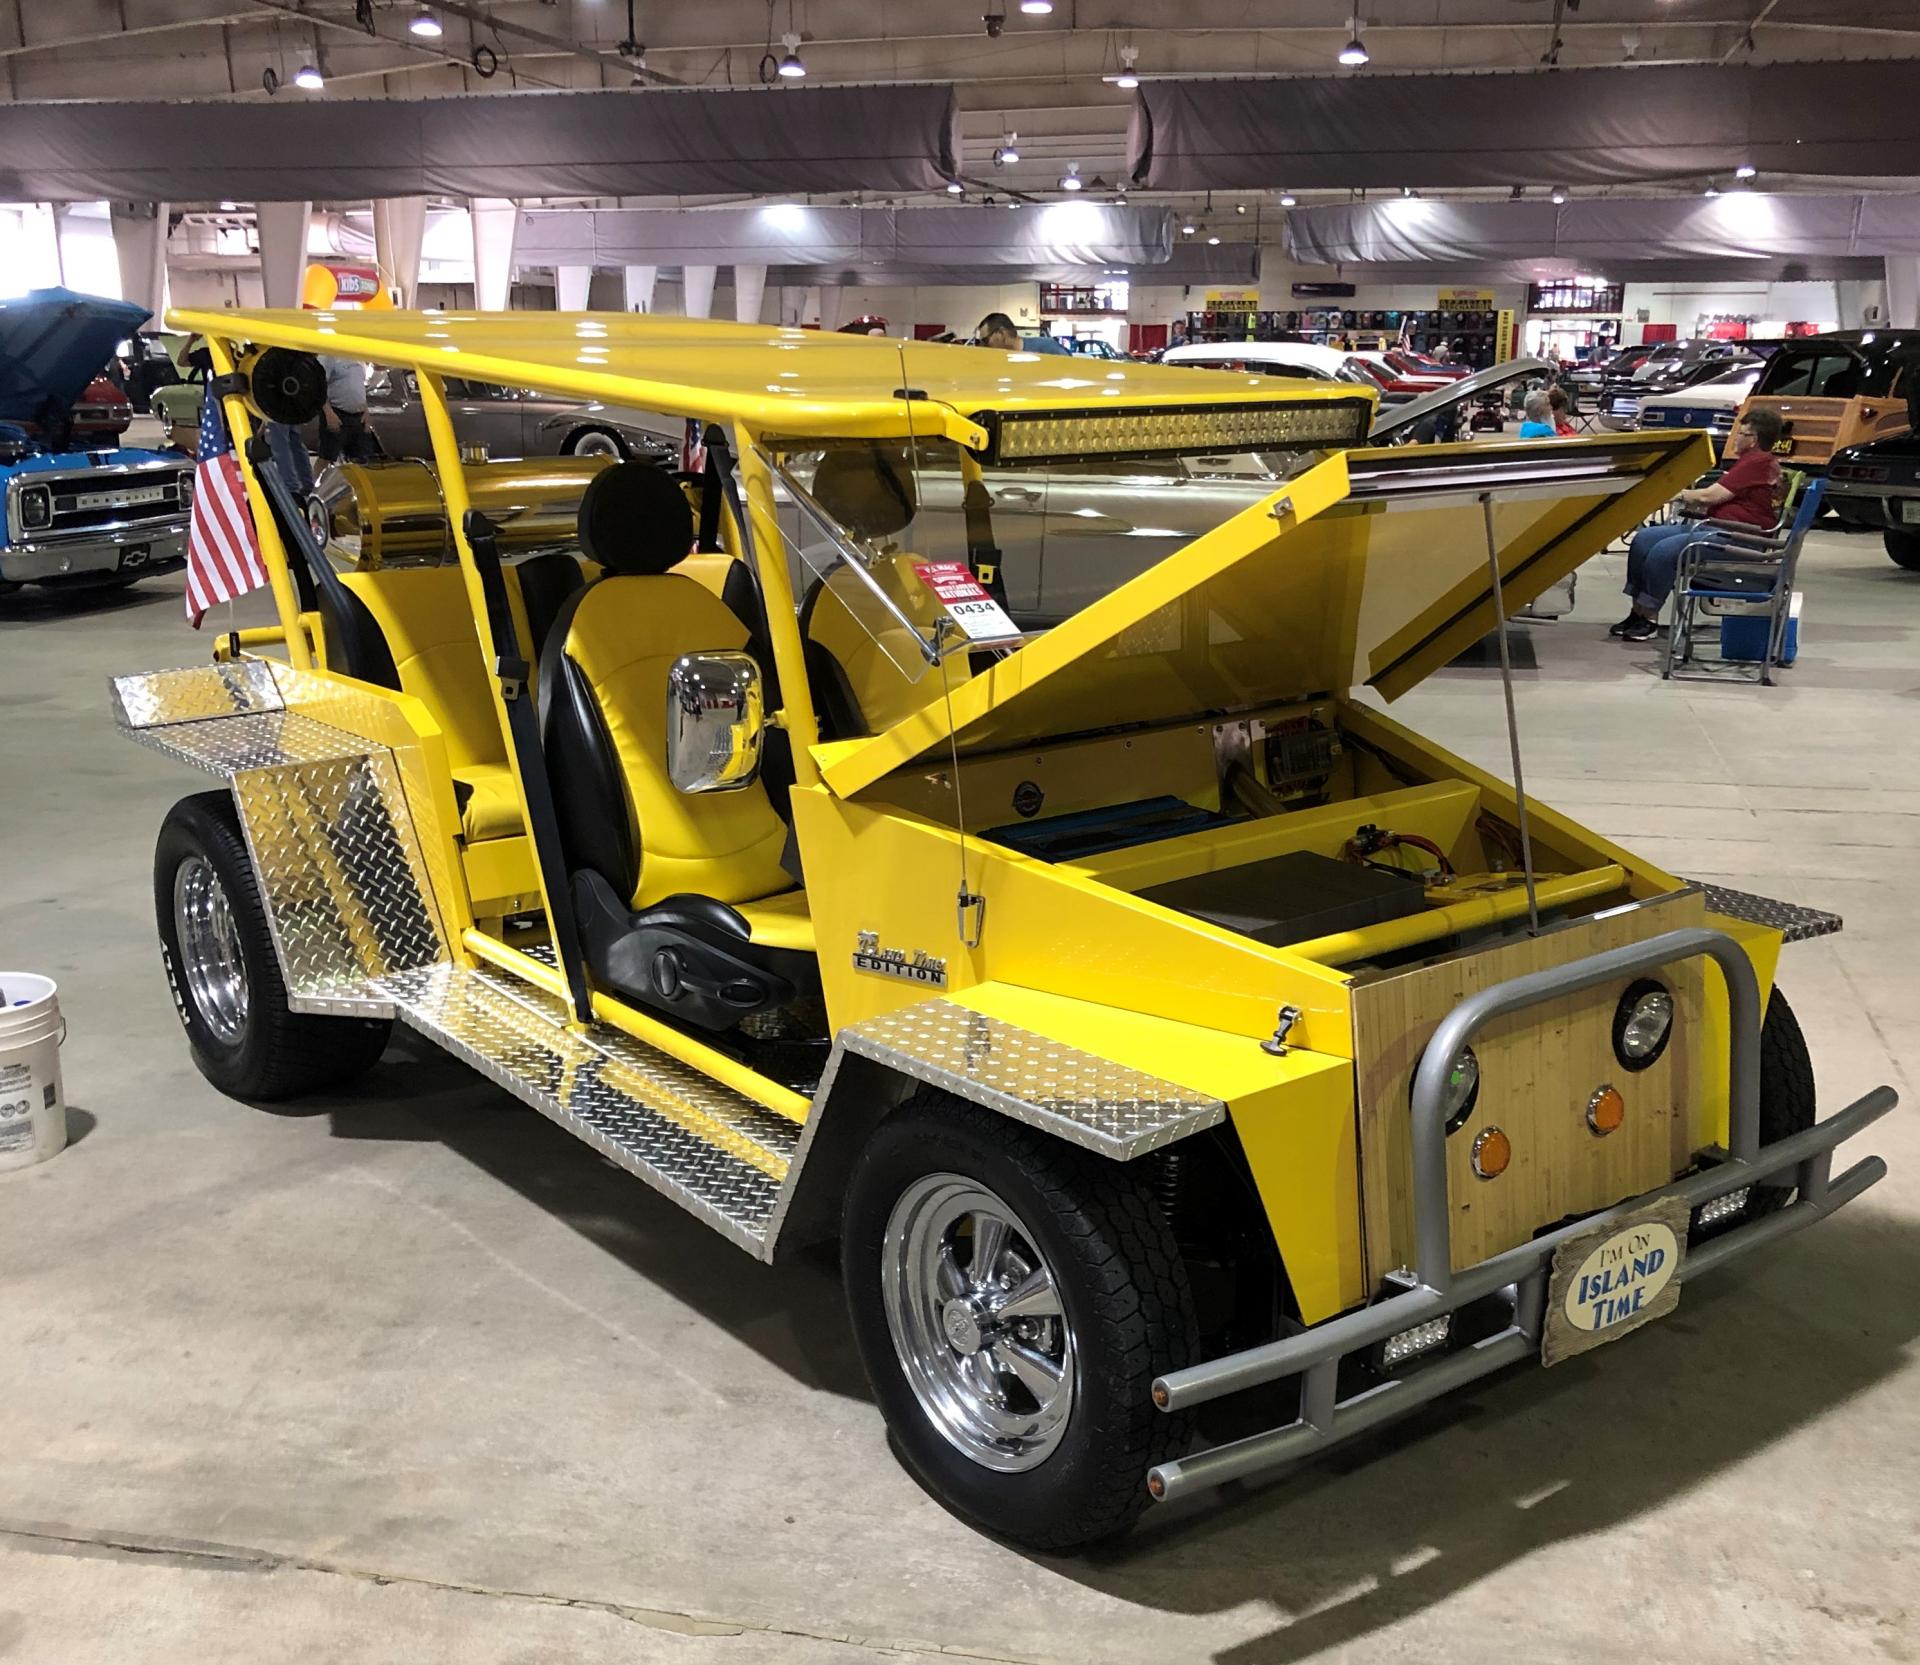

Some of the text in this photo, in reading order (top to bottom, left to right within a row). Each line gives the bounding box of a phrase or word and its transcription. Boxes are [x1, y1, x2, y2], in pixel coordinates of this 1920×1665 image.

[341, 276, 360, 291] KIDS
[953, 602, 995, 615] 0434
[857, 956, 941, 983] EDITION
[1600, 1233, 1650, 1267] I'M ON
[1577, 1248, 1665, 1305] ISLAND
[1593, 1286, 1645, 1328] TIME
